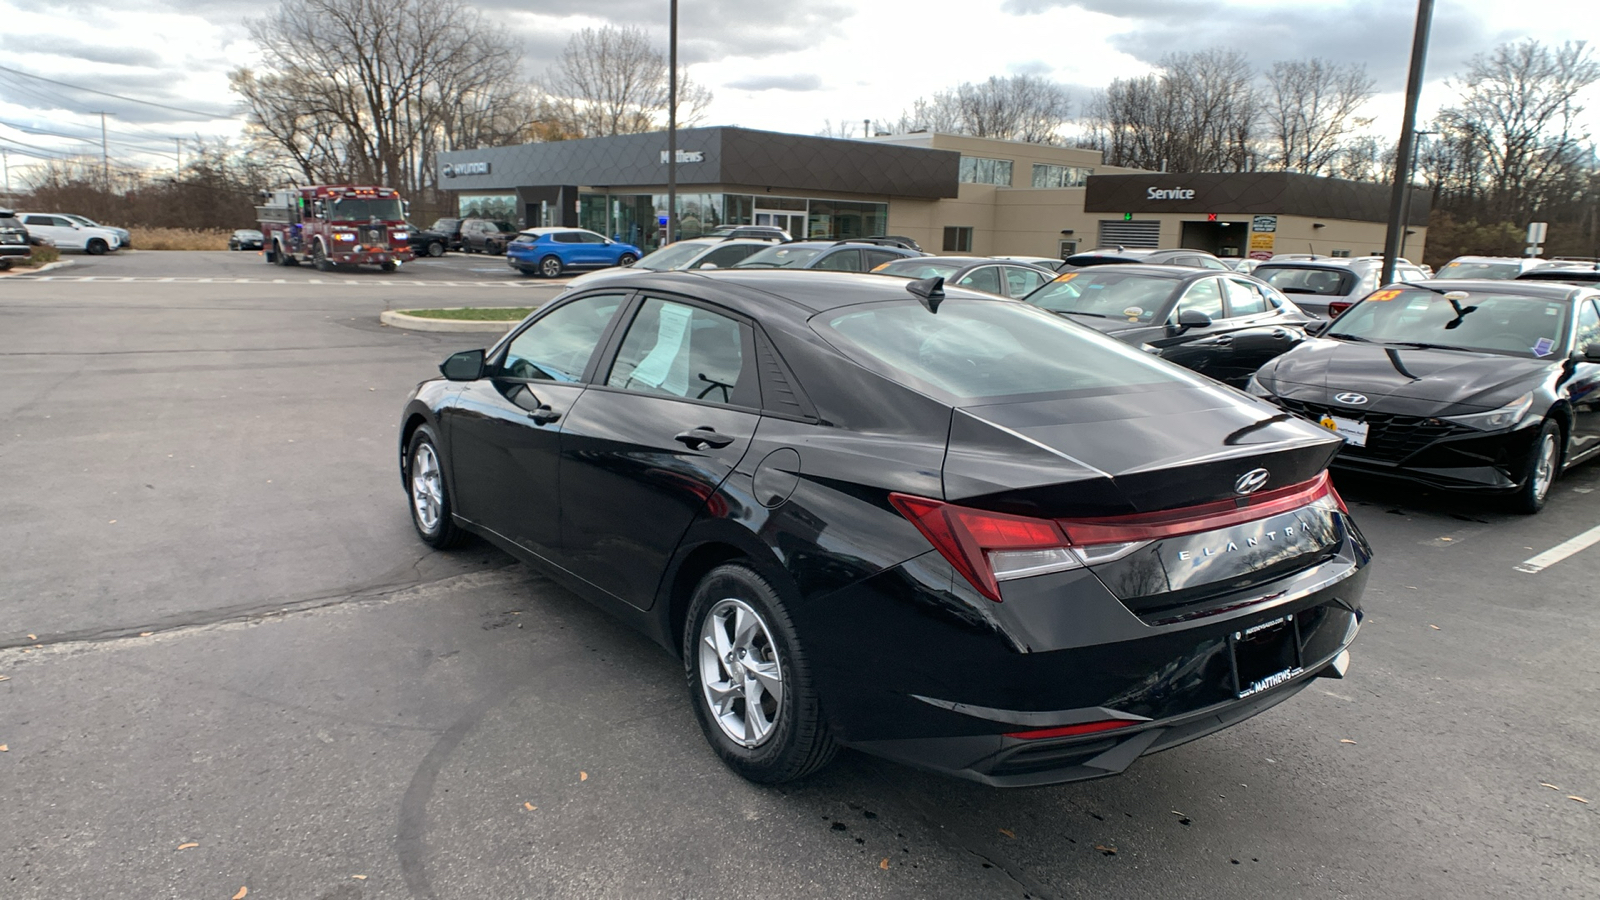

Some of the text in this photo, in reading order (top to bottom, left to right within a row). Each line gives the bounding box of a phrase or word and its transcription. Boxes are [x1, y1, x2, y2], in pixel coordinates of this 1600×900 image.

[454, 162, 488, 175] HYUNDAI
[1146, 186, 1196, 200] Service
[1178, 522, 1310, 561] ELANTRA
[1255, 668, 1292, 693] MATTHEWS
